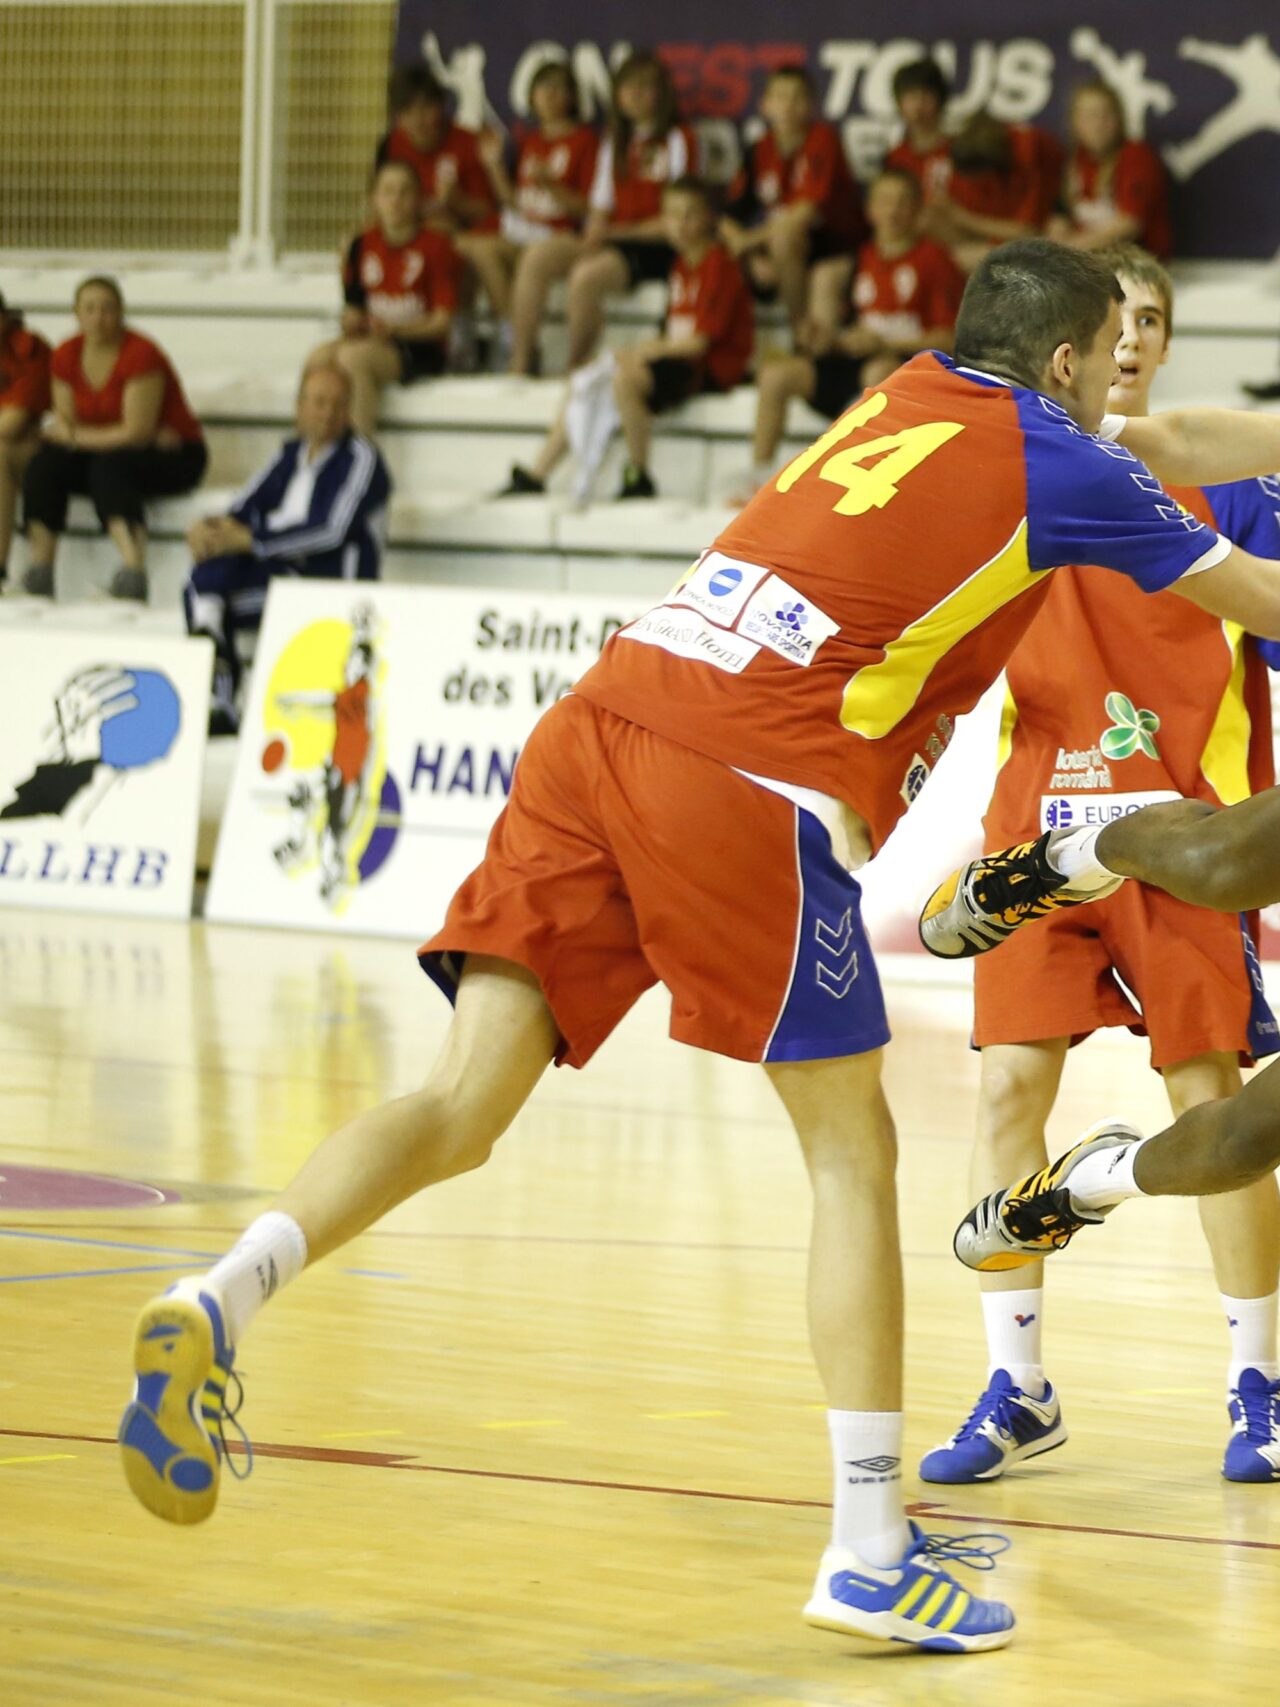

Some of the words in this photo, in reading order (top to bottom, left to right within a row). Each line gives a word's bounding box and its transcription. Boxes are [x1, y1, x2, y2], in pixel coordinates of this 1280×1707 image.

[774, 390, 967, 517] 14
[786, 628, 813, 652] VITA
[443, 667, 512, 706] des
